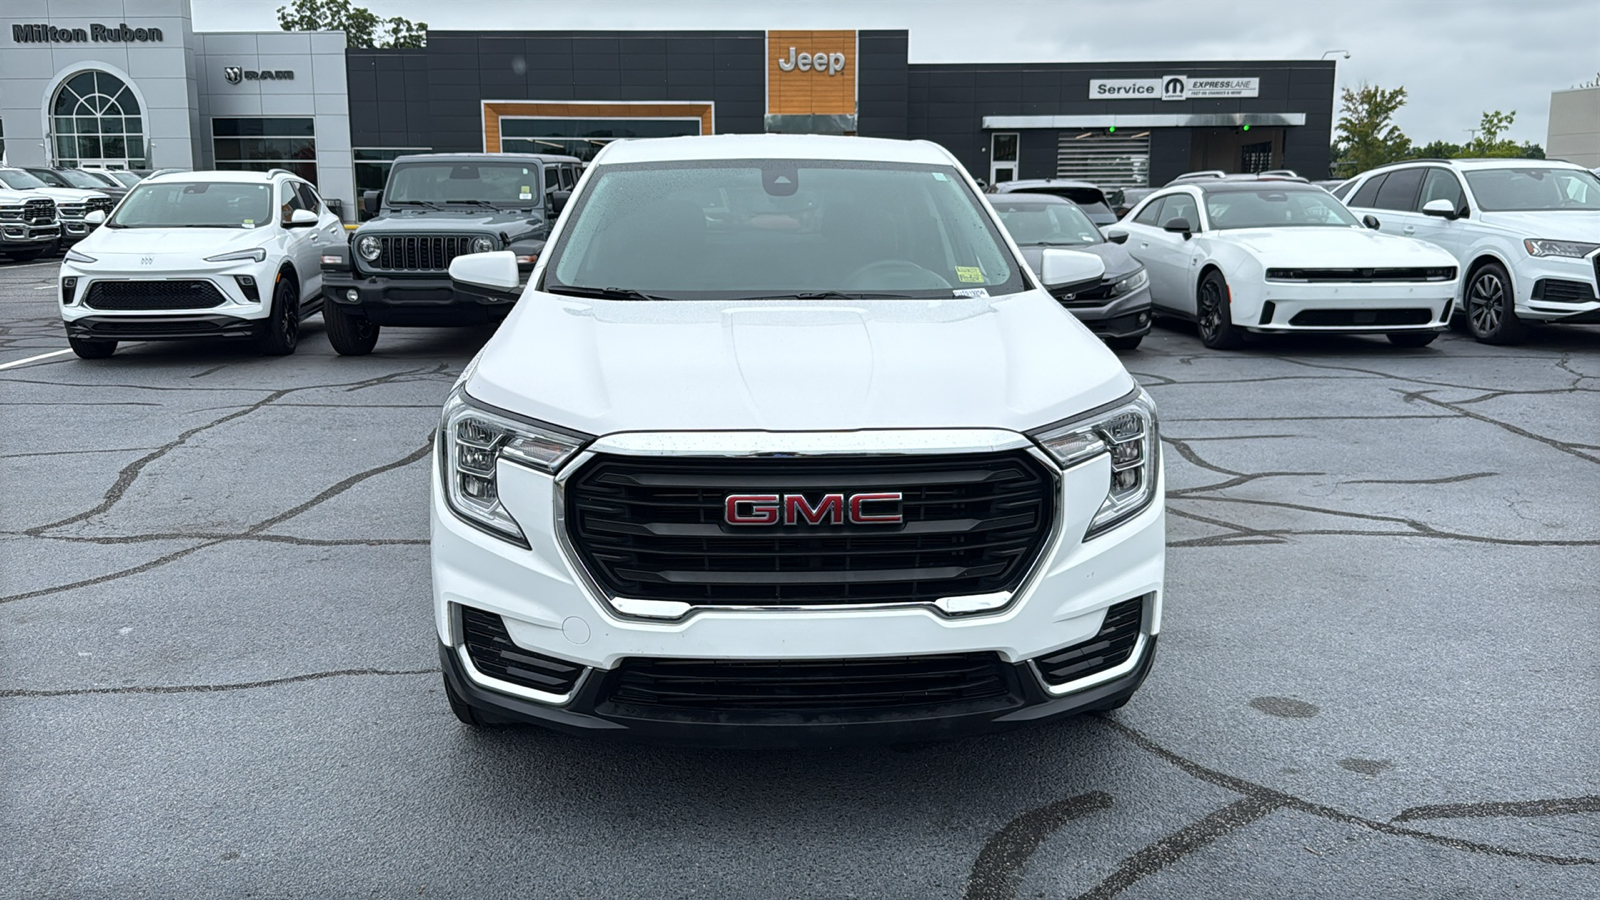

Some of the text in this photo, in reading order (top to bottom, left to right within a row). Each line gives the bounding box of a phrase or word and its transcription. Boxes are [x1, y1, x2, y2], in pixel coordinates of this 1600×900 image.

[12, 23, 163, 43] Milton Ruben
[778, 46, 846, 76] Jeep
[244, 70, 294, 81] RAM
[1097, 83, 1155, 95] Service
[724, 492, 903, 526] GMC
